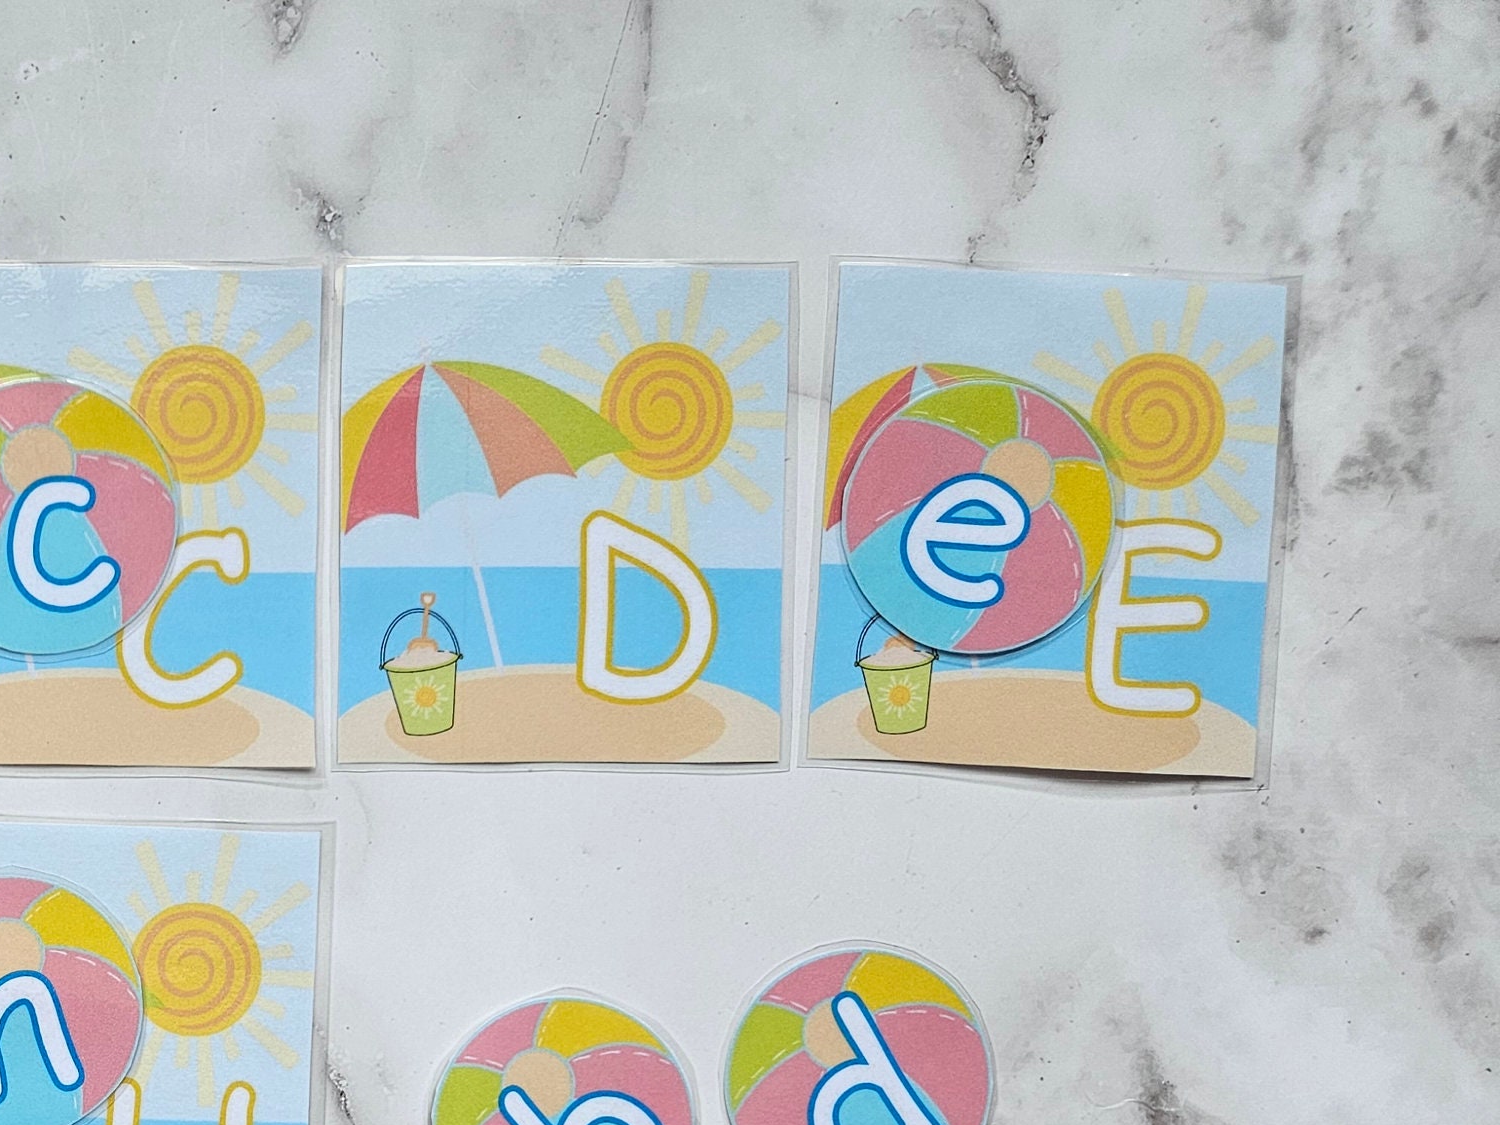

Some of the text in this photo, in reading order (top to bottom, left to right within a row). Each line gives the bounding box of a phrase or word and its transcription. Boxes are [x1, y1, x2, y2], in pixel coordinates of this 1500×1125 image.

[6, 475, 121, 614] c
[576, 510, 718, 706] D
[900, 473, 1031, 610] e
[1085, 517, 1222, 719] E
